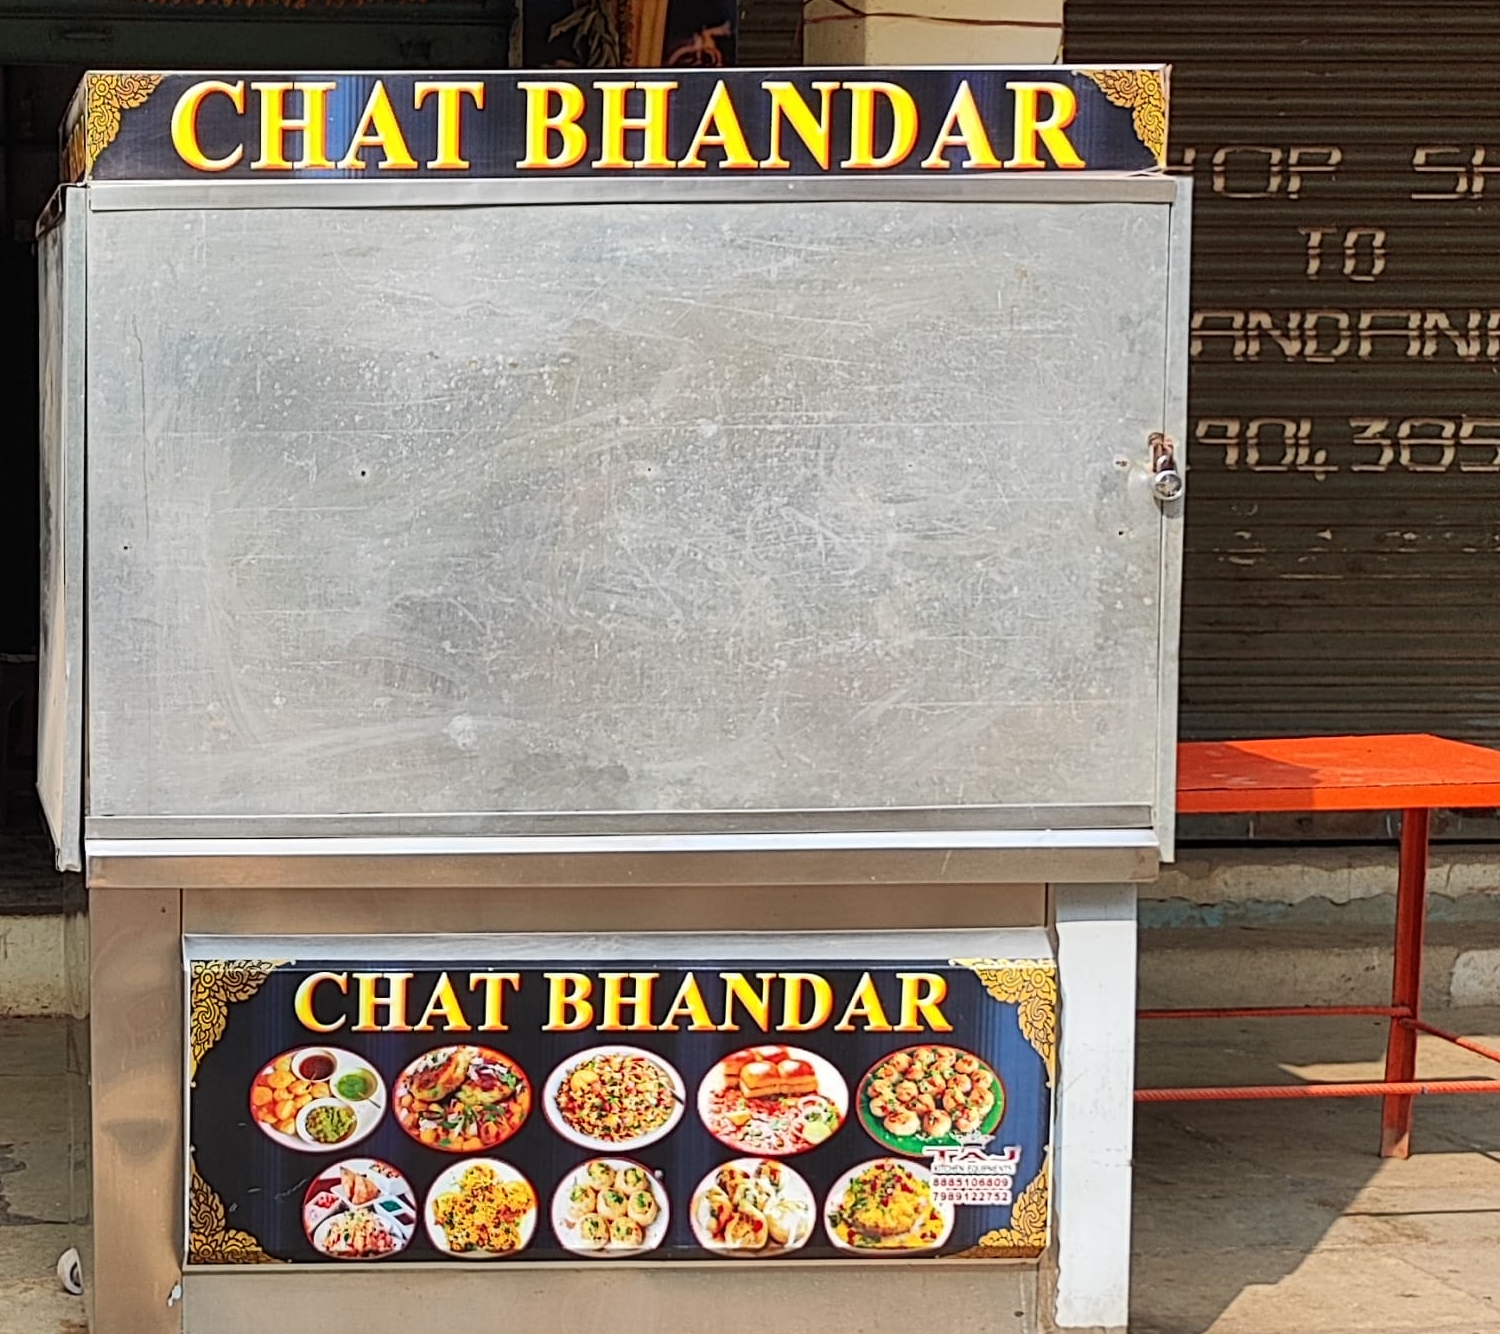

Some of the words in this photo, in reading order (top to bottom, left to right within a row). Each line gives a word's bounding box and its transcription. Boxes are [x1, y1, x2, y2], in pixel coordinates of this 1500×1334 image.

[171, 80, 484, 171] CHAT
[515, 79, 1088, 173] BHANDAR
[1299, 227, 1388, 282] TO
[293, 970, 522, 1034] CHAT
[541, 969, 955, 1034] BHANDAR
